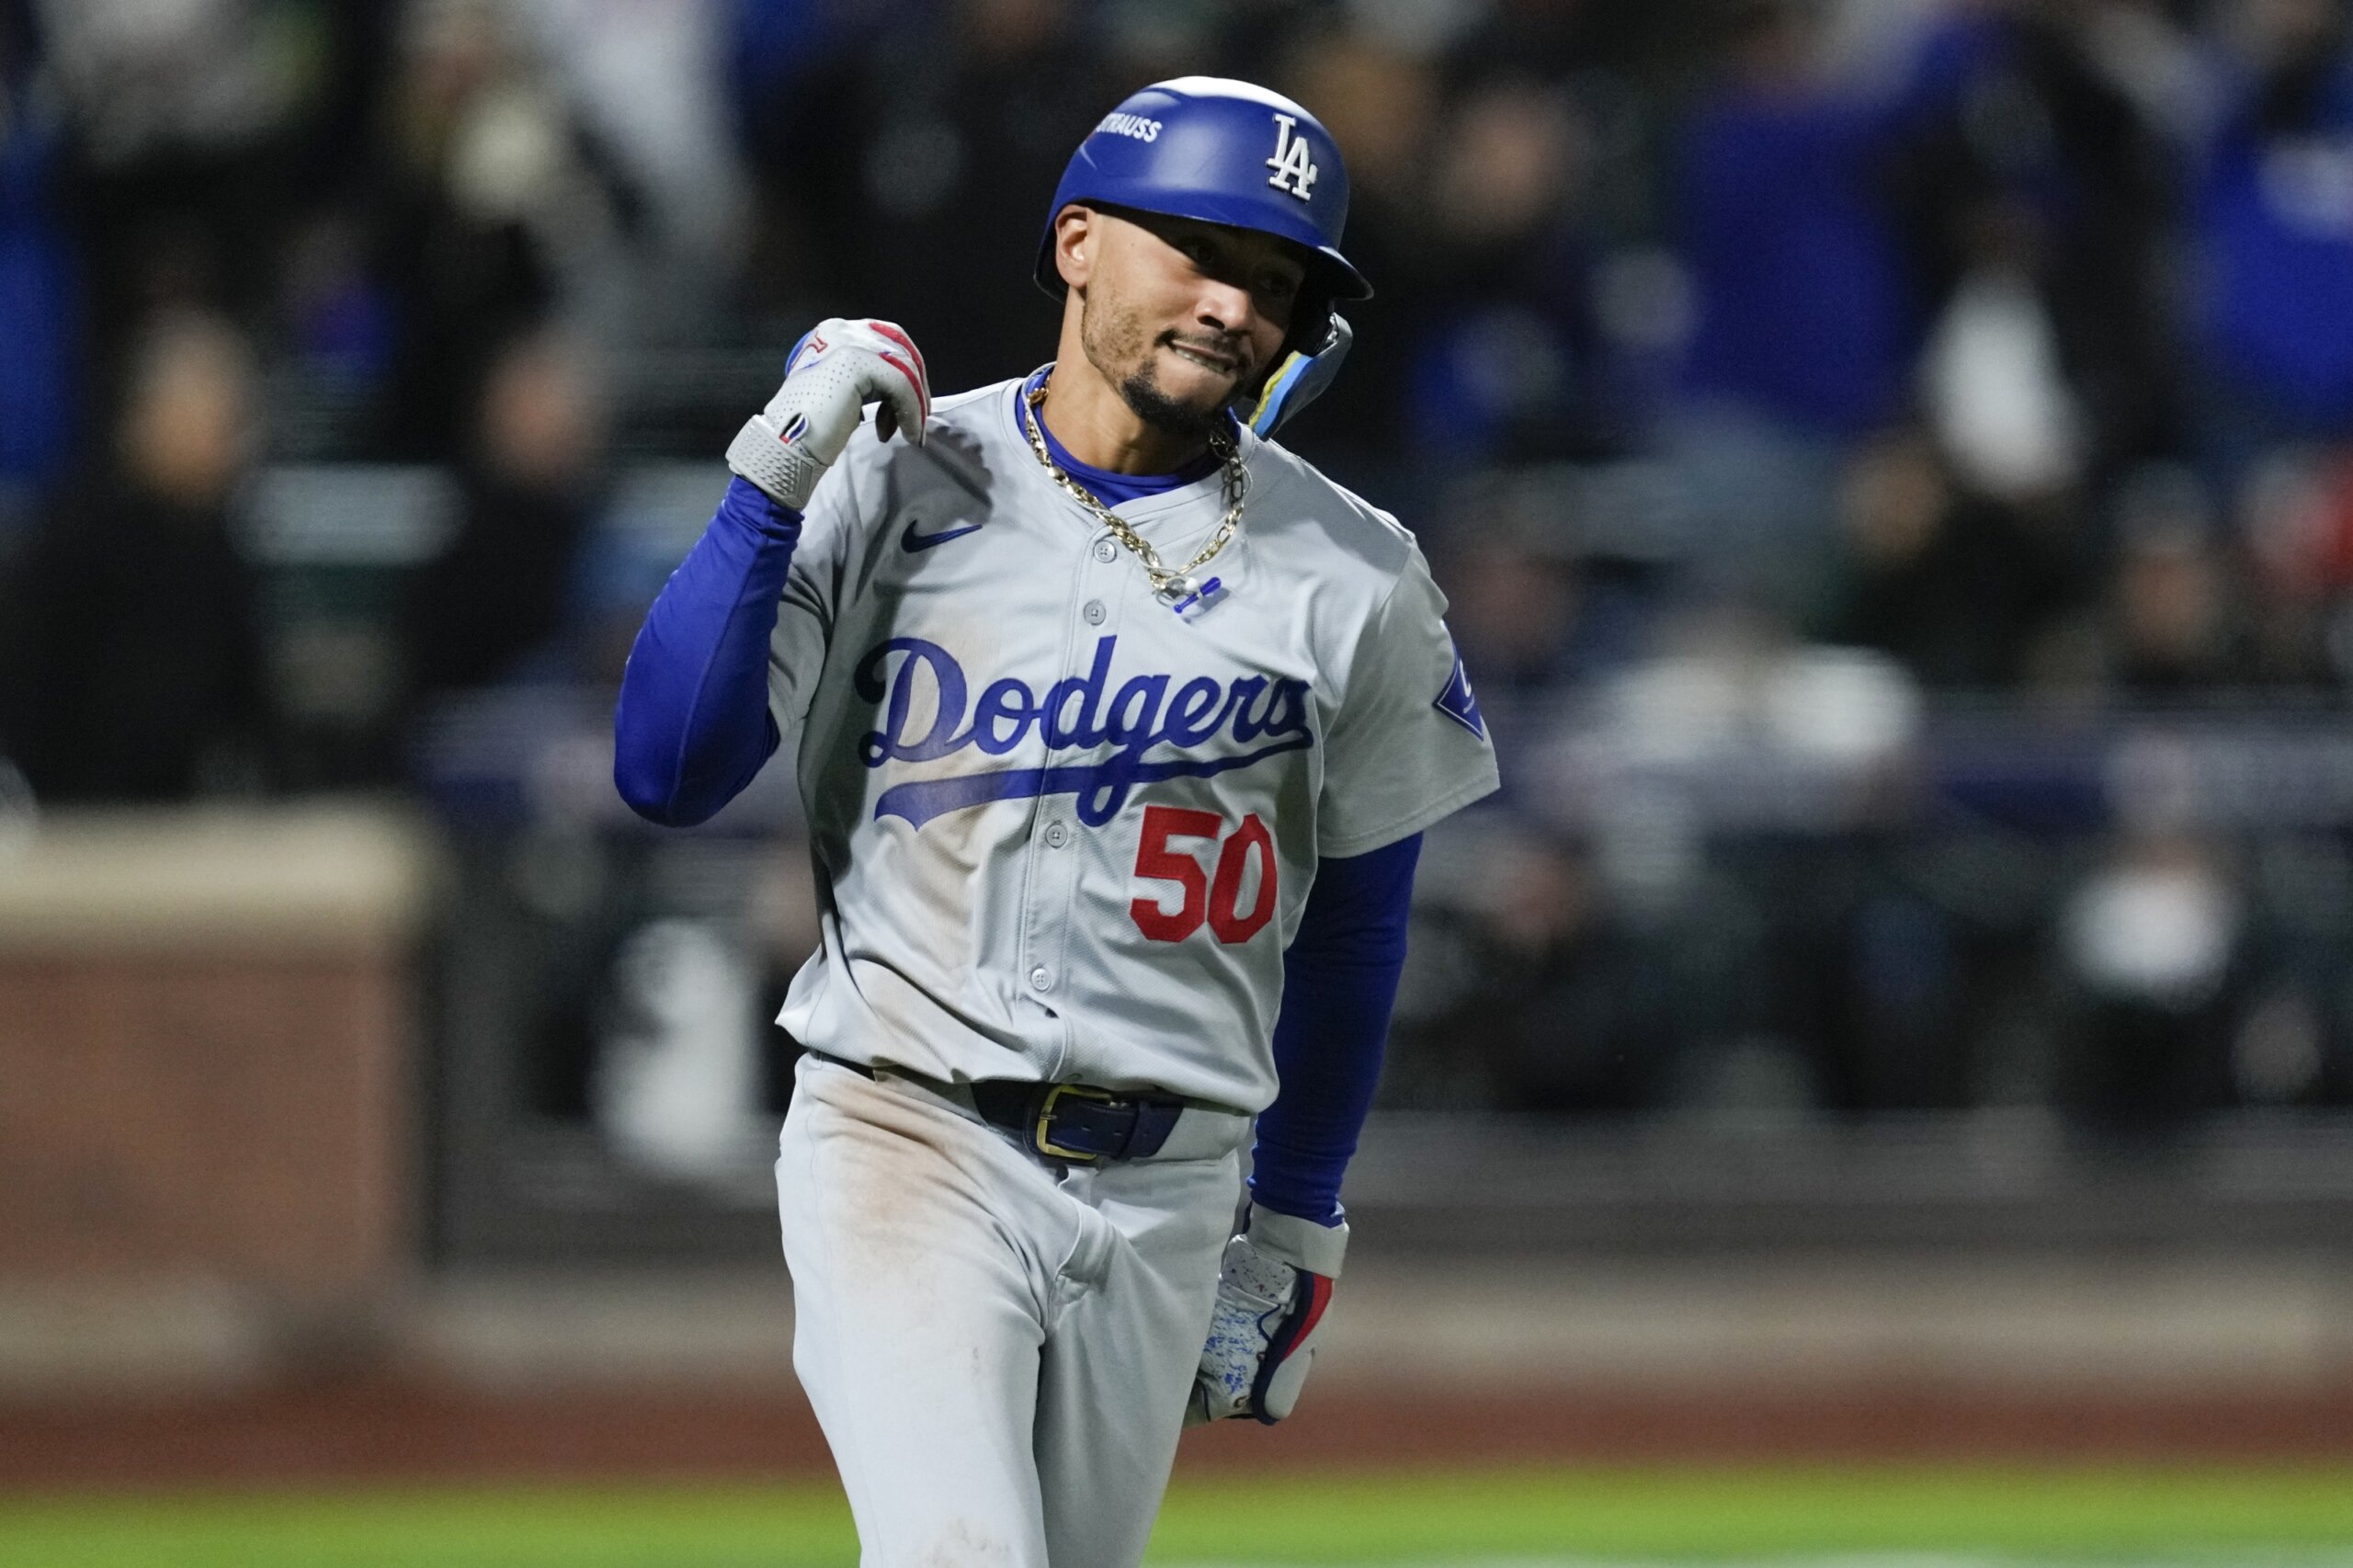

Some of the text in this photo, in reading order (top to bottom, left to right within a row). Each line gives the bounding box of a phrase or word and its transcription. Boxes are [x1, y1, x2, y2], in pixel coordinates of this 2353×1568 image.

[1095, 112, 1162, 142] TRAUSS
[1266, 113, 1318, 200] LA
[854, 634, 1314, 828] Dodgers
[1130, 804, 1278, 944] 50
